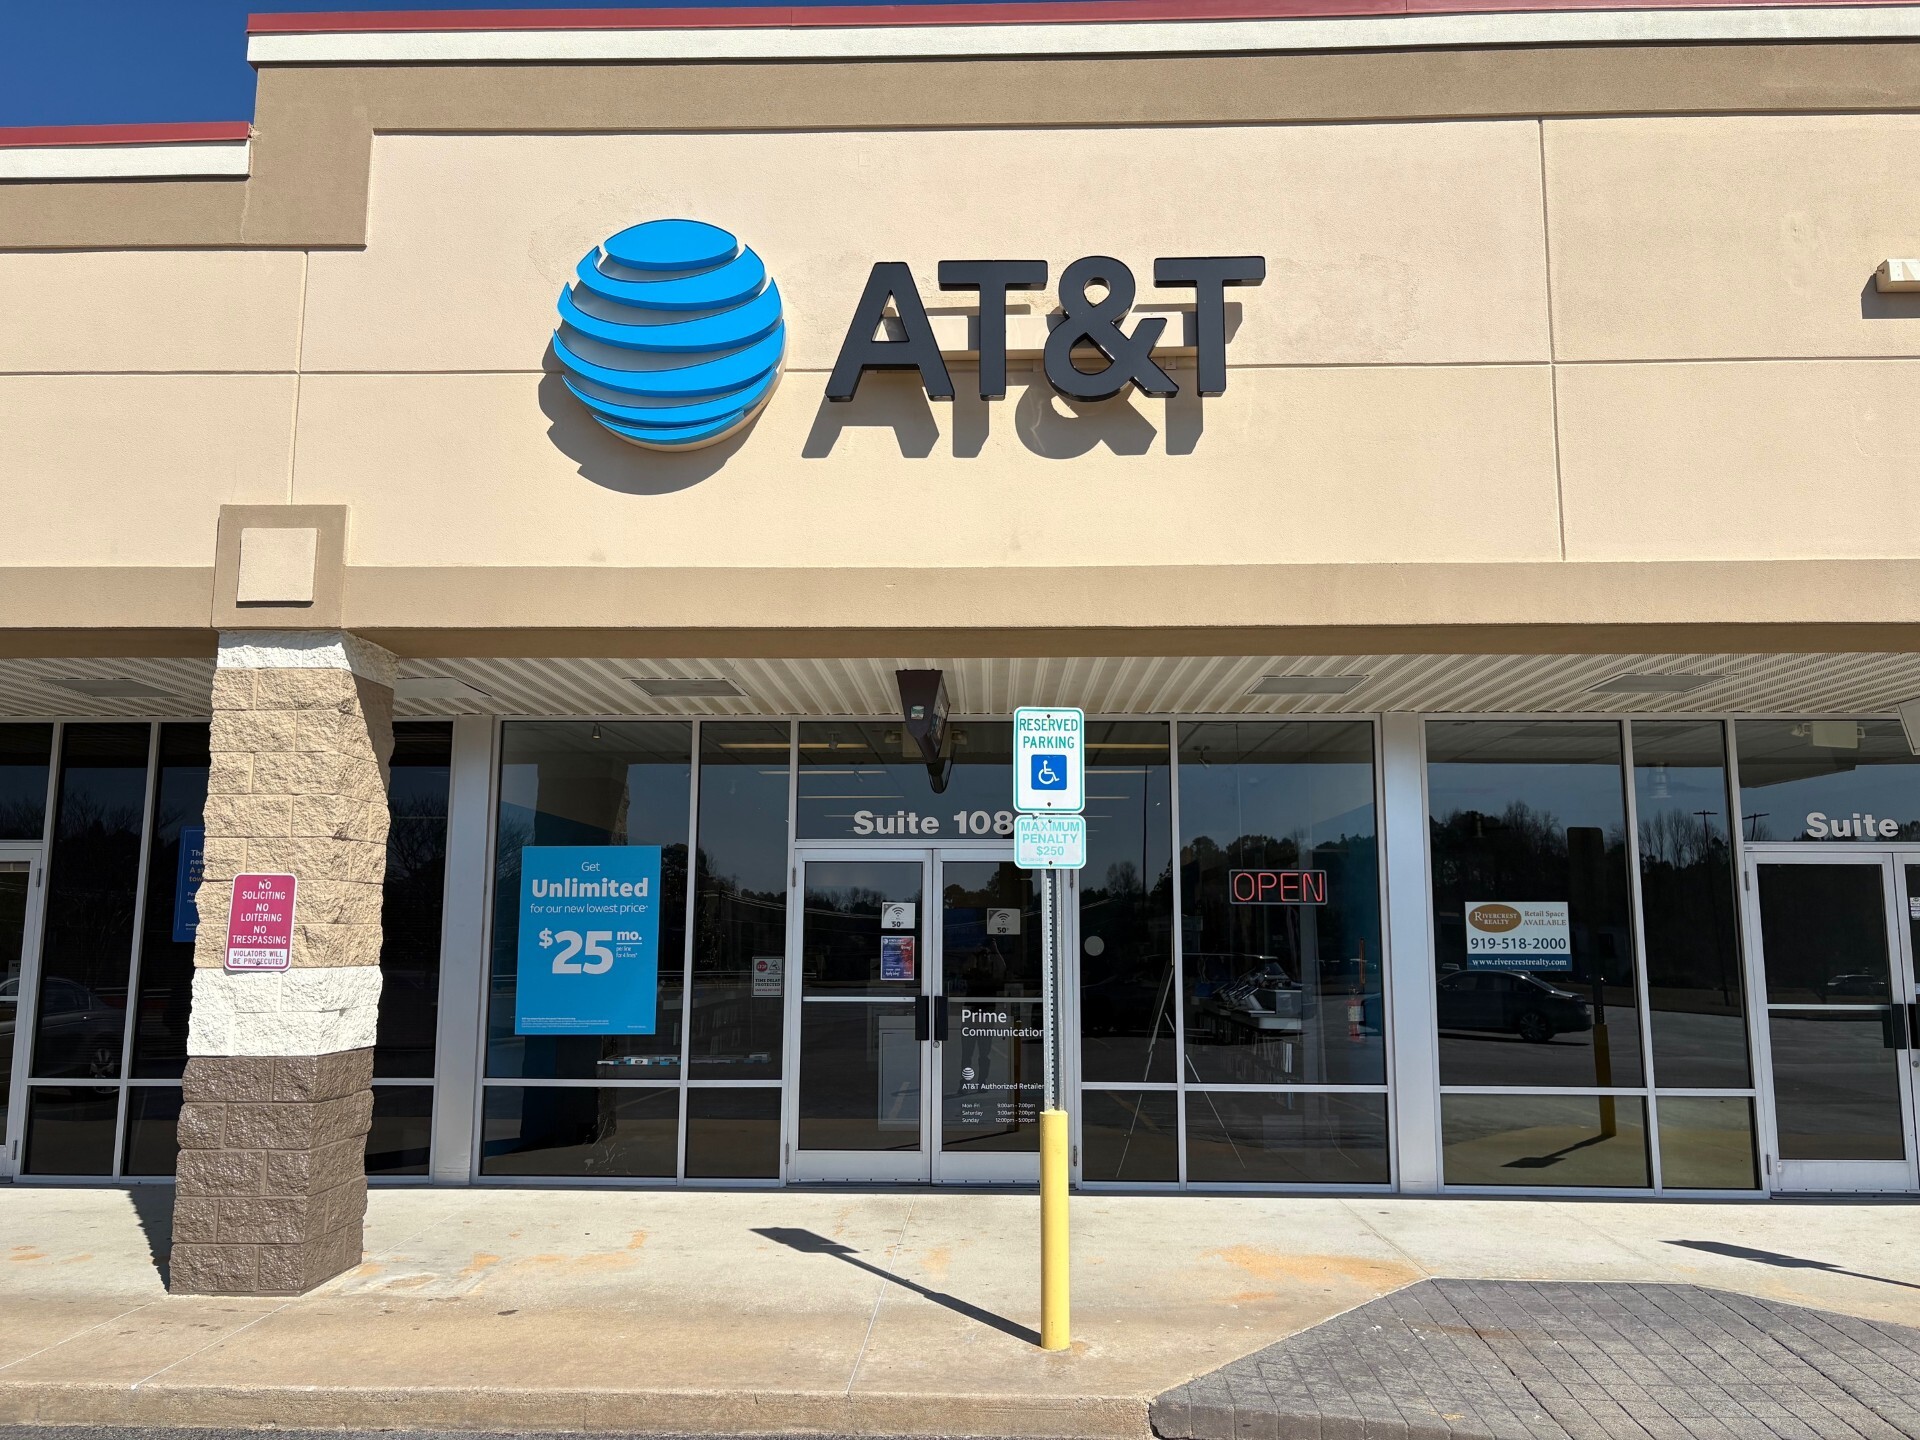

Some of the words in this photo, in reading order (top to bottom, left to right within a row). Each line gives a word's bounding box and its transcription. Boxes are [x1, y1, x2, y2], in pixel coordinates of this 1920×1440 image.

[824, 255, 1266, 402] AT&T
[1019, 718, 1079, 732] RESERVED
[1023, 735, 1075, 749] PARKING
[853, 810, 940, 835] Suite
[953, 810, 1014, 835] 108
[1021, 821, 1080, 832] MAXIMUM
[1806, 812, 1899, 838] Suite
[1022, 833, 1078, 844] PENALTY
[1036, 845, 1064, 856] $250
[581, 861, 600, 872] Get
[258, 881, 272, 890] NO
[532, 877, 649, 898] Unlimited
[1234, 872, 1323, 902] OPEN
[241, 891, 286, 900] SOLICITING
[255, 903, 269, 912] NO
[530, 903, 544, 913] for
[545, 905, 562, 913] our
[564, 905, 584, 913] new
[586, 903, 618, 913] lowest
[240, 913, 282, 922] LOITERING
[1545, 910, 1565, 918] Space
[253, 925, 267, 934] NO
[232, 935, 287, 945] TRESPASSING
[1470, 937, 1567, 950] 919-518-2000
[538, 927, 614, 975] $25
[616, 930, 643, 941] mo.
[232, 957, 241, 965] BE
[243, 957, 284, 965] PROSECUTED
[1472, 958, 1567, 967] www.rivercrestrealty.com
[961, 1009, 1007, 1023] Prime
[980, 1082, 1018, 1090] Authorized
[1019, 1082, 1045, 1090] Retailer
